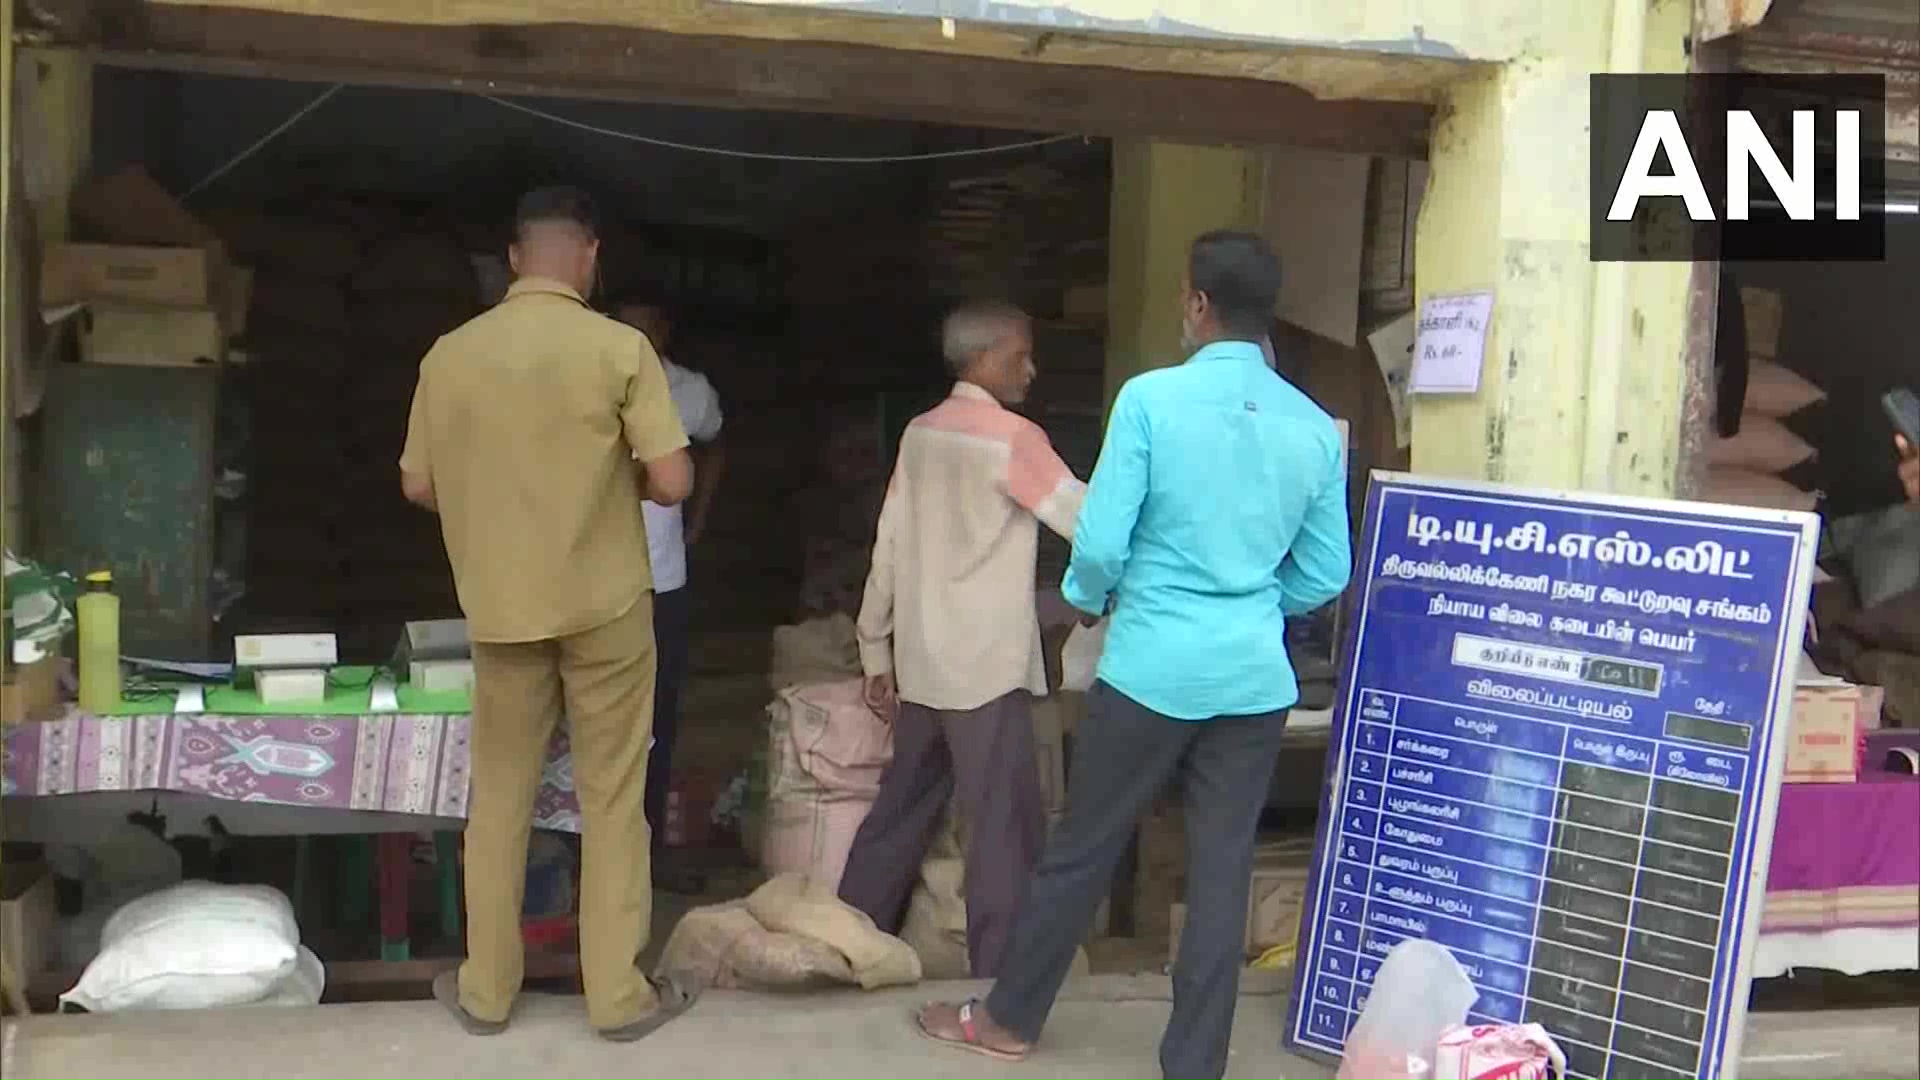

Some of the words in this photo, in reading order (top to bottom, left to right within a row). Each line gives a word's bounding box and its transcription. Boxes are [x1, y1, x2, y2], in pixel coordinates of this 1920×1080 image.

[1407, 513, 1755, 580] டி.யு.சி.எஸ்.லிட்
[1381, 553, 1549, 594] திருவல்லிக்கேணி
[1551, 579, 1598, 603] நகர
[1600, 586, 1692, 619] கூட்டுறவு
[1695, 597, 1772, 625] சங்கம்
[1427, 593, 1485, 619] நியாய
[1488, 603, 1543, 628] விலை
[1549, 615, 1635, 643] கடையின்
[1638, 629, 1697, 653] பெயர்
[1467, 678, 1633, 720] விலைப்பட்டியல்
[1366, 733, 1376, 745] 1.
[1396, 738, 1449, 760] சர்க்கரை
[1360, 761, 1371, 773] 2.
[1356, 789, 1367, 801] 3.
[1352, 817, 1363, 830] 4.
[1384, 822, 1444, 847] கோதுமை
[1347, 845, 1359, 858] 5.
[1343, 873, 1354, 886] 6.
[1422, 865, 1459, 884] பருப்பு
[1339, 902, 1350, 914] 7.
[1435, 898, 1473, 918] பருப்பு
[1334, 930, 1345, 942] 8.
[1329, 957, 1341, 970] 9.
[1323, 985, 1339, 999] 10.
[1318, 1013, 1335, 1028] 11.
